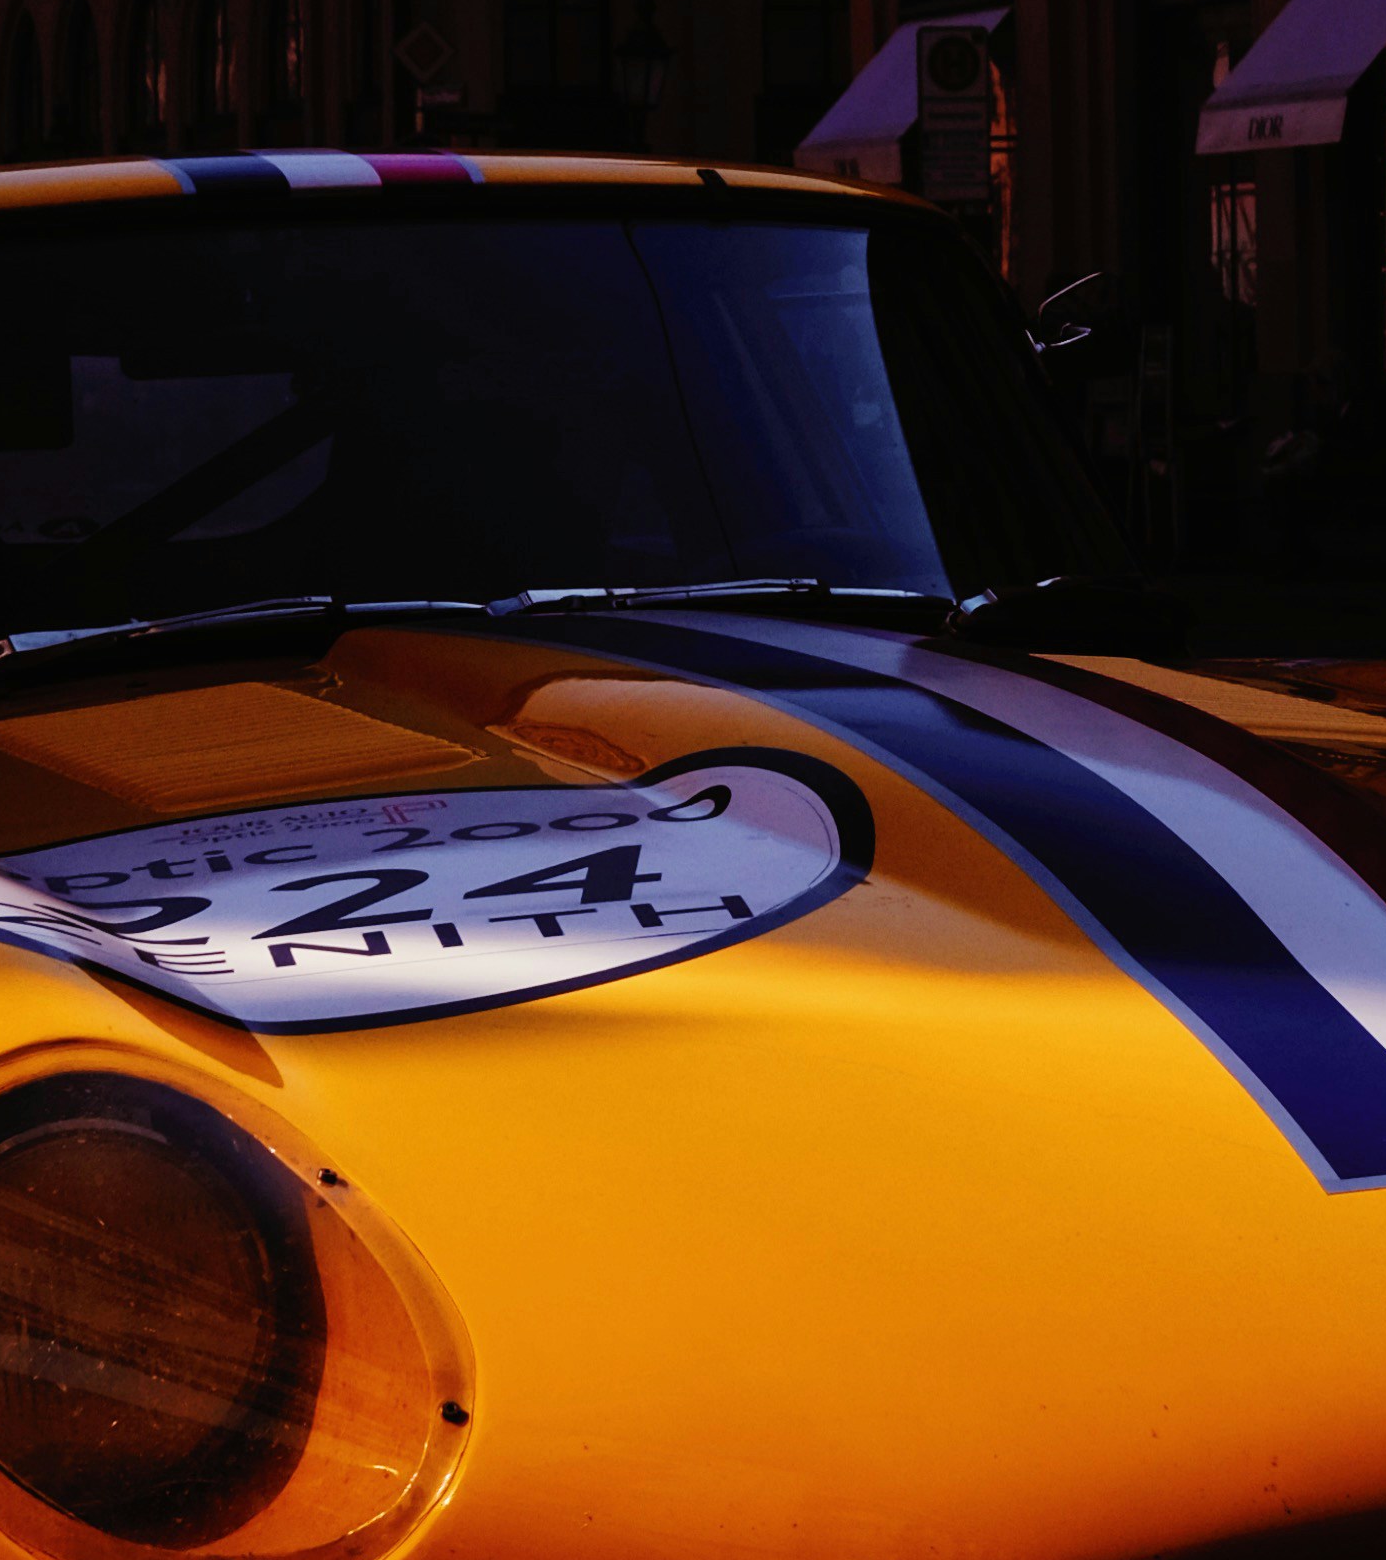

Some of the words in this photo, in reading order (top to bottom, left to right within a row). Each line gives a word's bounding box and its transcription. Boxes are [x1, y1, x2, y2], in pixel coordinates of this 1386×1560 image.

[1247, 115, 1285, 141] DIOR
[4, 843, 318, 895] ptic
[363, 784, 733, 853] 2000
